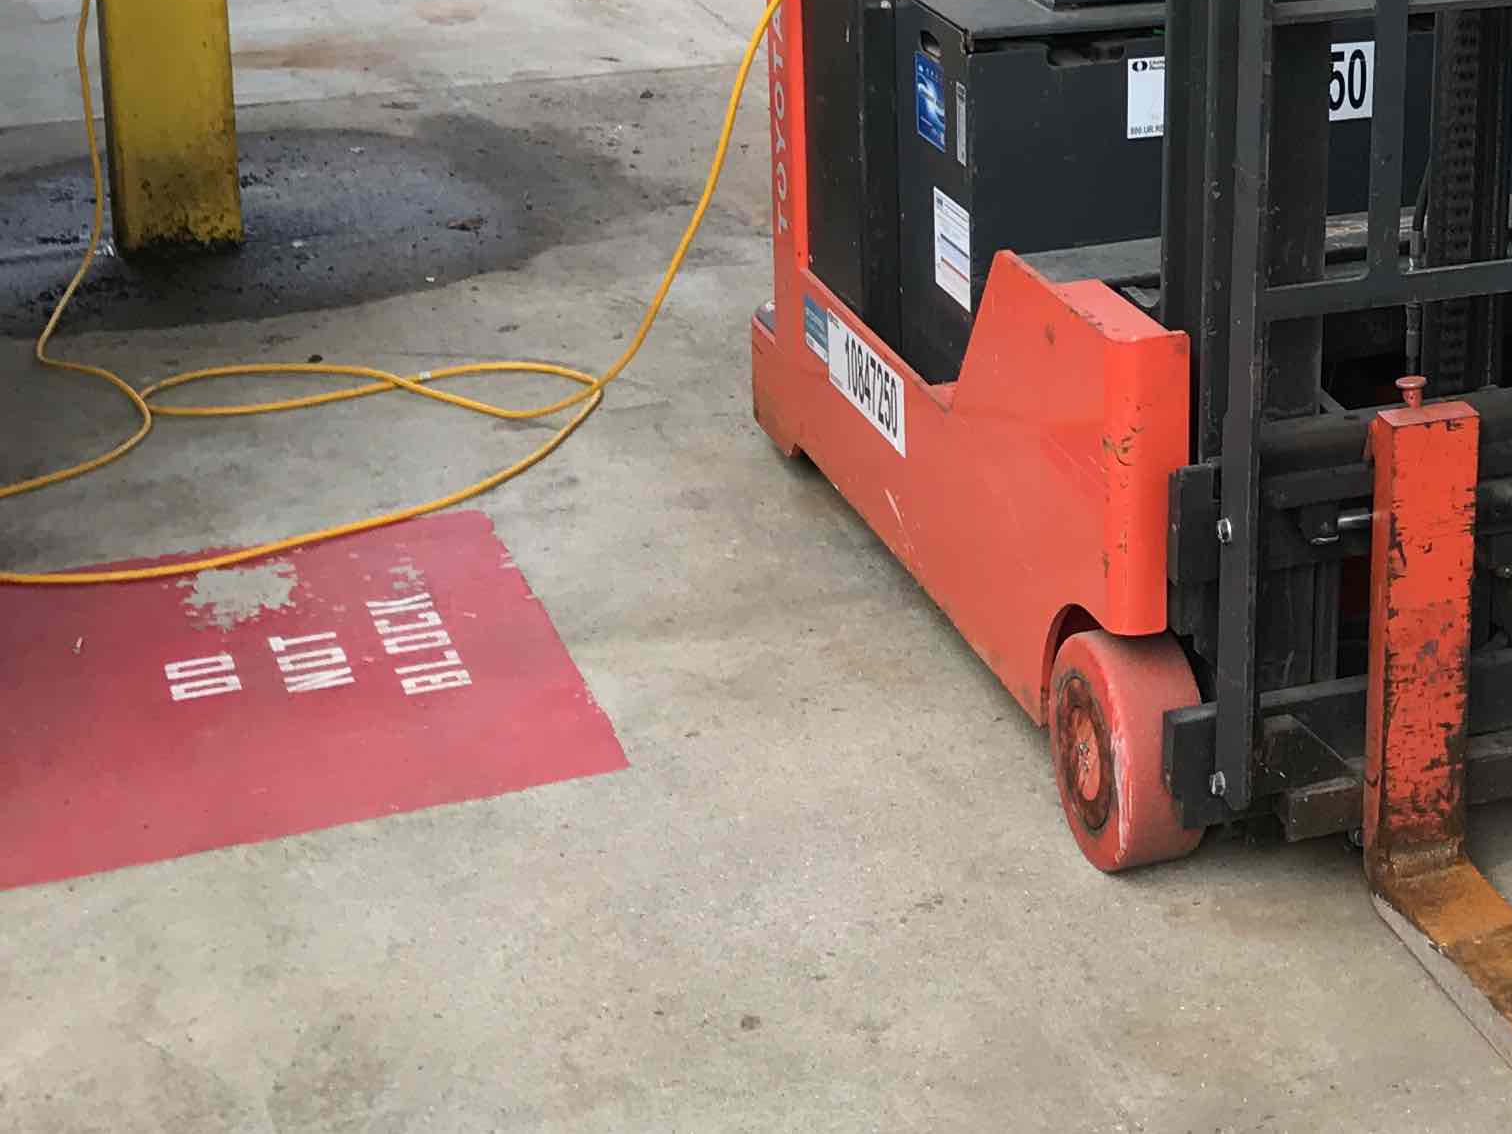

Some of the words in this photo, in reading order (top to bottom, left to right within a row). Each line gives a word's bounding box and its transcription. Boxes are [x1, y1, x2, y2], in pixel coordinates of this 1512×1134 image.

[772, 6, 789, 235] TOYOTA
[845, 333, 898, 438] 10847250
[164, 653, 242, 701] DO
[267, 631, 355, 693] NOT
[366, 592, 472, 695] BLOCK
